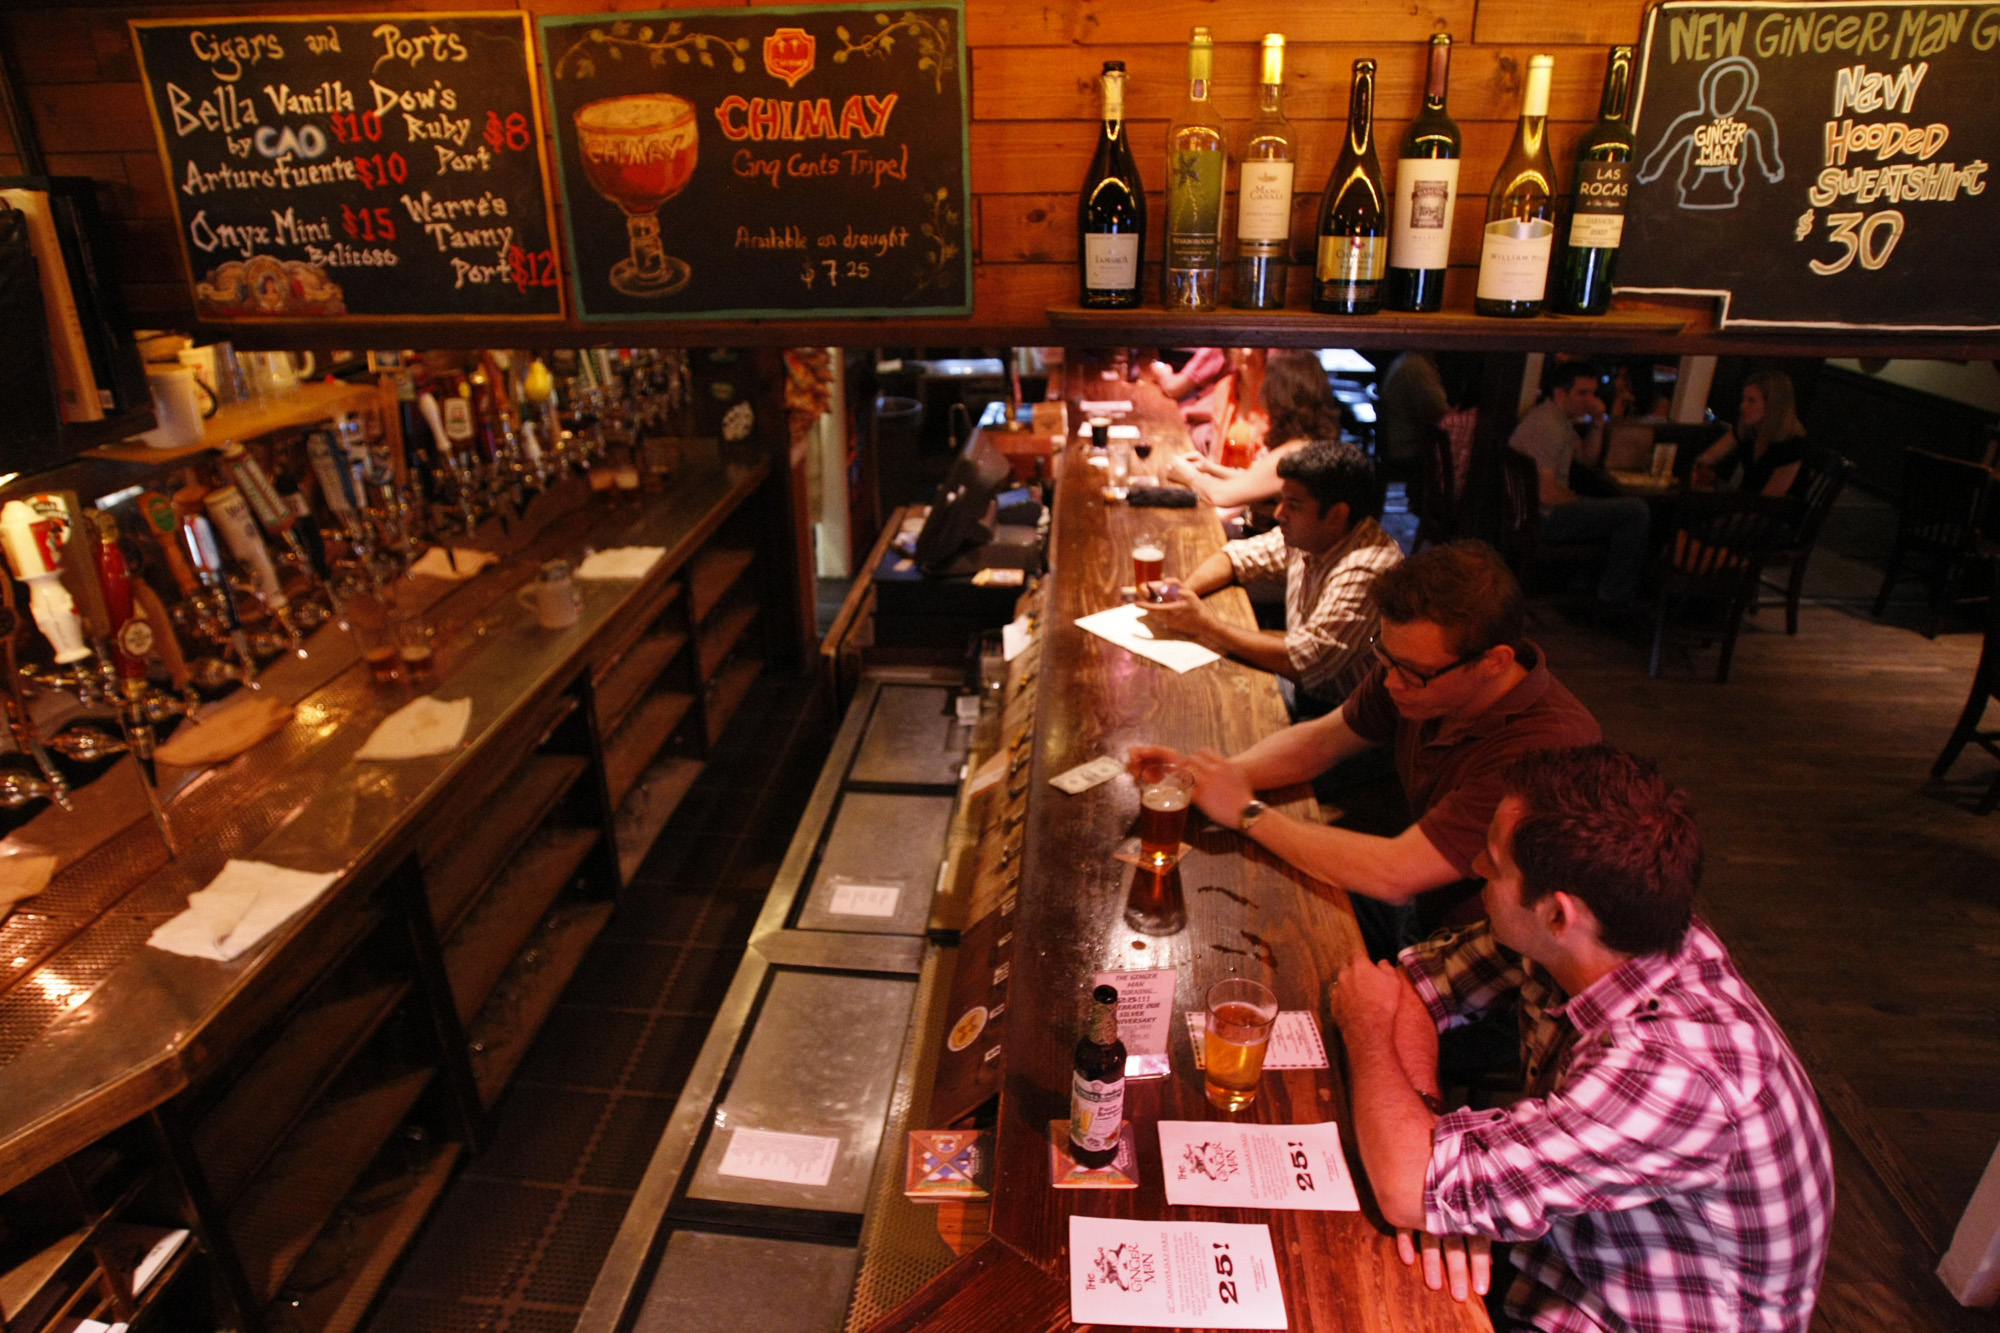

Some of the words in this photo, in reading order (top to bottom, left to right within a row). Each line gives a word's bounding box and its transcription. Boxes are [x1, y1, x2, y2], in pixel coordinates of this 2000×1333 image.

[190, 30, 284, 82] Cigars
[304, 26, 341, 54] and
[372, 23, 468, 74] Ports
[1669, 12, 1748, 64] NEW
[1971, 7, 2000, 51] G
[166, 82, 258, 137] Bella
[263, 80, 355, 116] Vanilla
[368, 80, 458, 118] Dow's
[715, 92, 898, 142] CHIMAY
[226, 135, 252, 158] by
[254, 124, 327, 159] CAO
[330, 108, 382, 145] $10
[403, 112, 471, 144] Ruby
[483, 110, 531, 153] $8
[587, 134, 685, 165] CHIMAY
[1694, 122, 1748, 147] GINGER
[1701, 143, 1738, 161] MAN
[182, 159, 276, 196] Arturo
[273, 151, 356, 189] Fuente
[354, 151, 408, 191] $10
[434, 145, 492, 175] Port
[787, 152, 840, 178] Cents
[841, 143, 909, 189] Tripel
[1596, 168, 1621, 180] LAS
[400, 191, 508, 223] Warre's
[1580, 182, 1629, 196] ROCAS
[190, 209, 270, 258] Onyx
[271, 206, 332, 247] Mini
[340, 203, 397, 242] $15
[424, 222, 514, 252] Tawny
[734, 225, 808, 249] Available
[817, 234, 837, 248] on
[843, 225, 910, 257] draught
[303, 242, 399, 268] Belicoso
[450, 250, 511, 290] Port
[508, 244, 559, 294] $12
[1288, 1141, 1315, 1192] 25!
[1213, 1242, 1239, 1305] 25!
